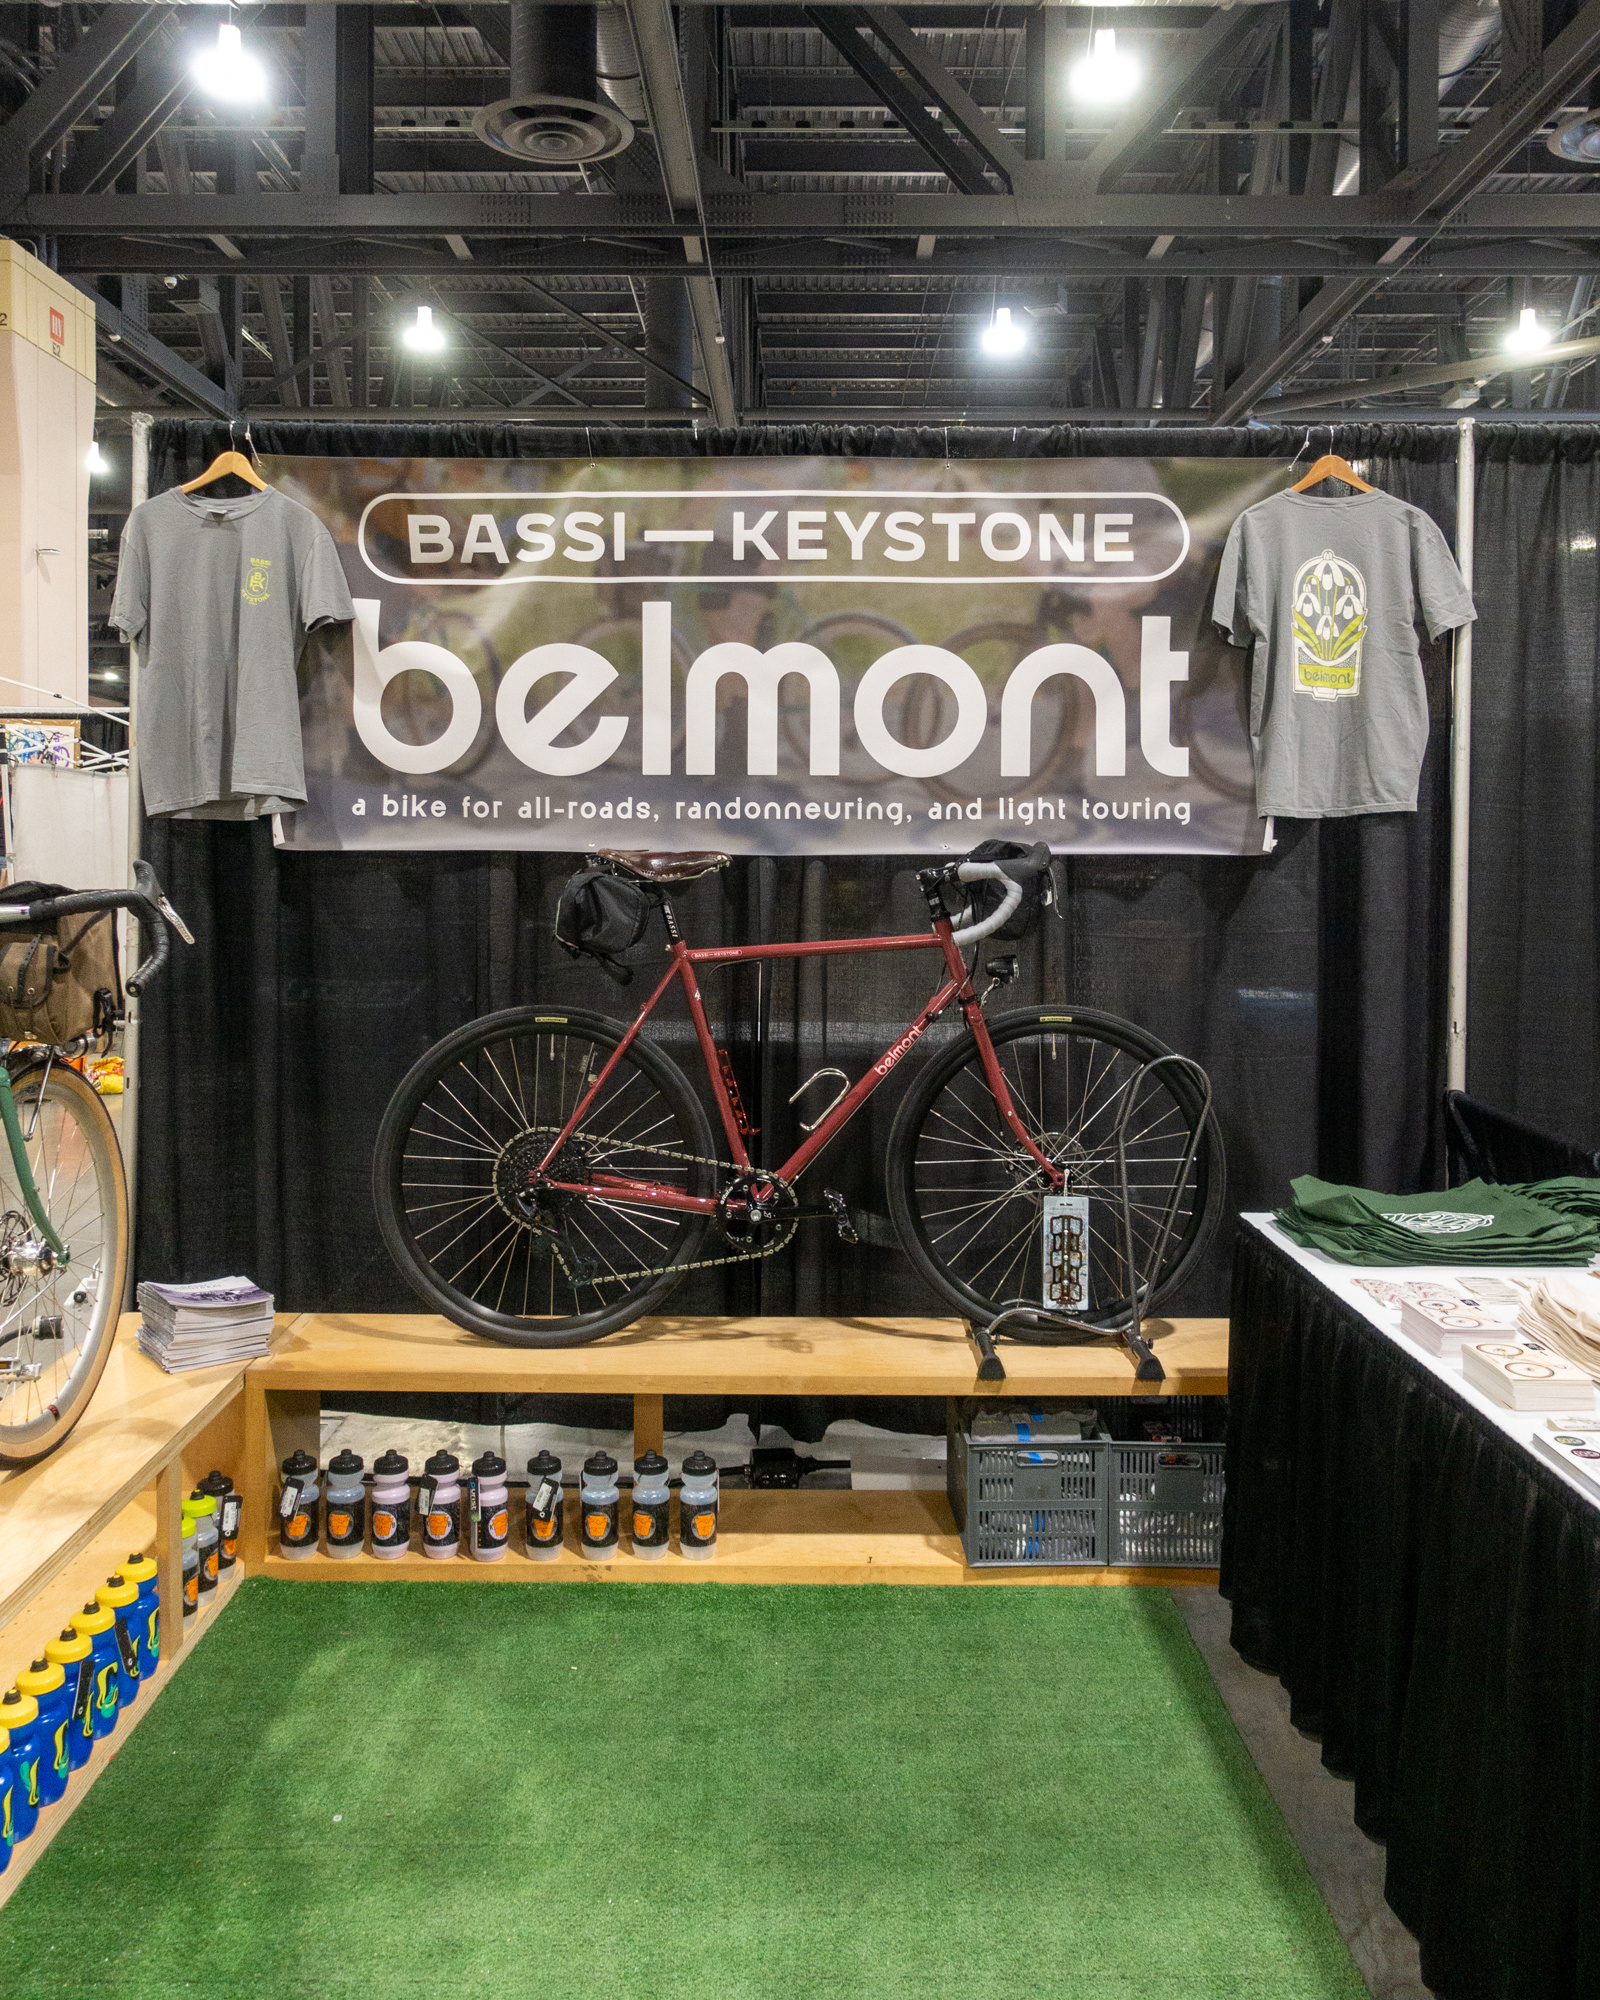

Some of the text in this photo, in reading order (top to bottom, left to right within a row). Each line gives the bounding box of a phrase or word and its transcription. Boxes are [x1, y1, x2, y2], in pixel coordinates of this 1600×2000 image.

[52, 341, 61, 358] E2
[406, 511, 626, 564] BASSI
[732, 510, 1135, 563] KEYSTONE
[250, 557, 271, 566] BASSI
[241, 589, 270, 602] KEYSTONE
[1303, 668, 1351, 684] belmont
[351, 598, 1191, 778] belmont
[351, 793, 1191, 826] a bike for all-roads, randonneuring, and light touring
[666, 915, 678, 937] BASSI
[873, 1024, 923, 1076] belmont
